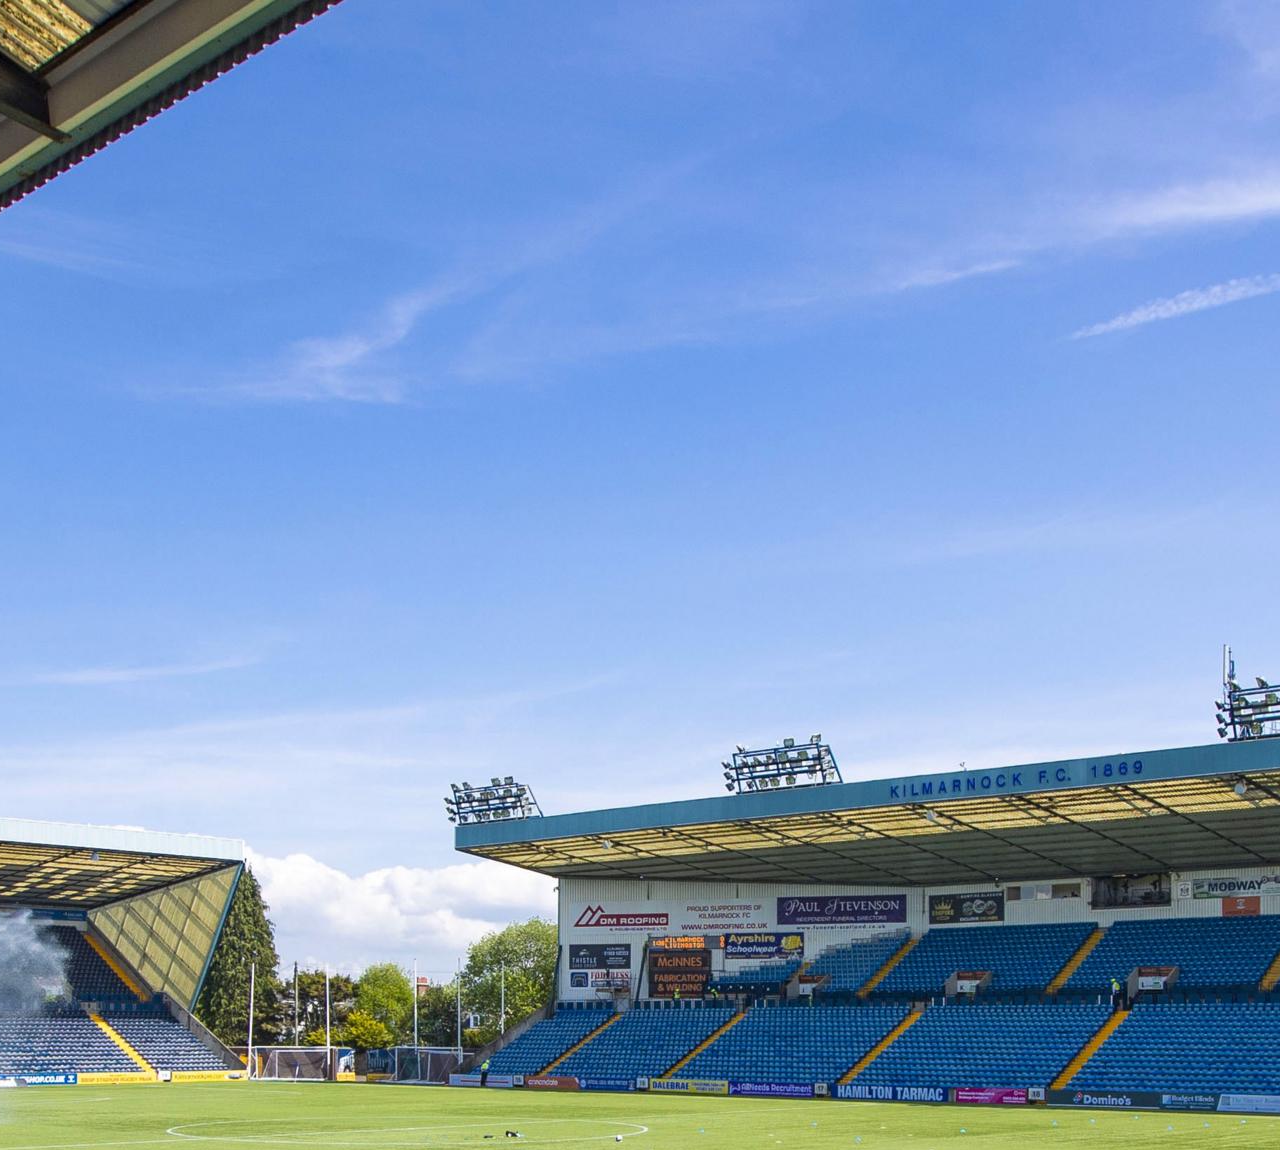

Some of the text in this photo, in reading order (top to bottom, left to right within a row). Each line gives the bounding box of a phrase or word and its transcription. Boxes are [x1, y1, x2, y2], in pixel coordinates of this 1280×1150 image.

[889, 760, 1143, 798] KILMARNOCK F.C. 1869
[1208, 880, 1264, 892] MODWAY
[784, 898, 900, 916] PAUL STEVENSON
[728, 934, 775, 944] Ayrshire
[726, 945, 778, 953] Schoolwear
[657, 957, 702, 967] McINNES
[654, 974, 706, 982] FABRICATION
[771, 1084, 812, 1092] Recruitment
[837, 1085, 892, 1099] HAMILTON
[896, 1087, 943, 1100] TARMAC
[1083, 1094, 1131, 1105] Domino's
